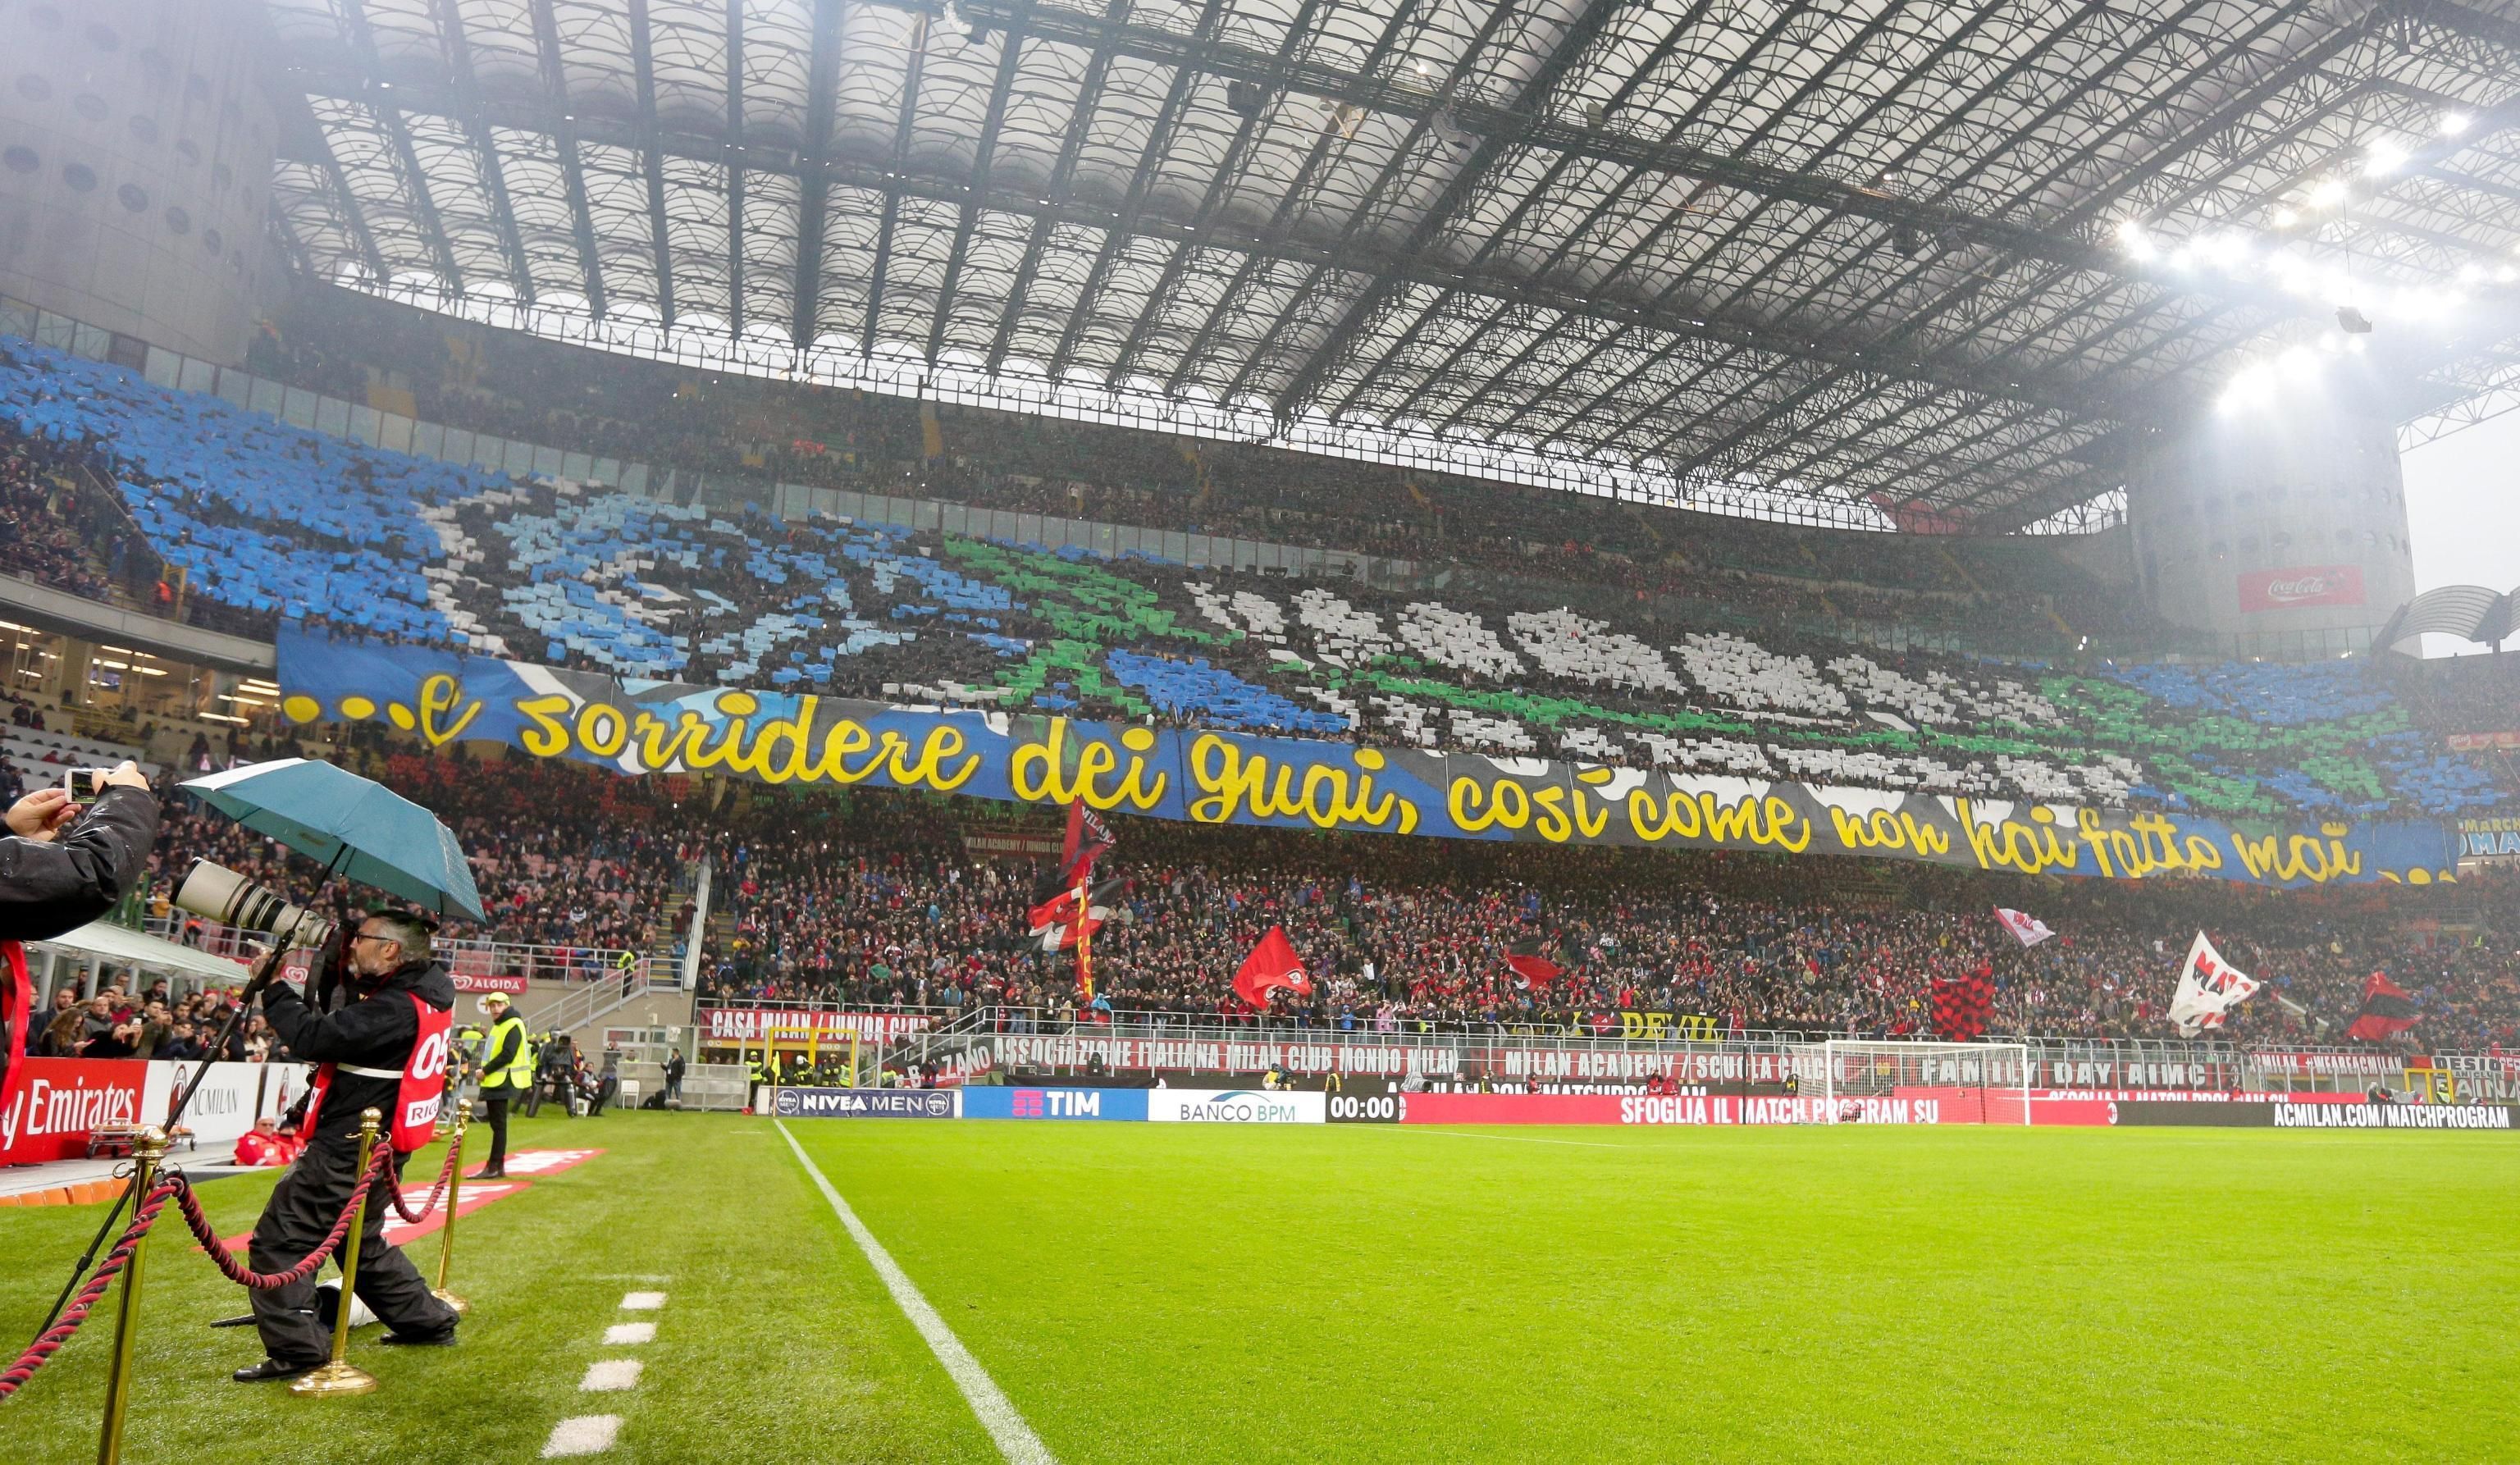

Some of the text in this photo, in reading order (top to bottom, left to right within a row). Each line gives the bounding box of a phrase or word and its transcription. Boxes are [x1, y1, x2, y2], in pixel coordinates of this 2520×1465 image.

[516, 692, 980, 791] sorridere
[1011, 716, 1166, 810] dei
[1189, 734, 1418, 834] guai,
[1628, 788, 1810, 853] come
[1831, 806, 1950, 856] non
[1956, 796, 2078, 874] hai
[2079, 807, 2221, 879] fatto
[987, 837, 1020, 851] ACADEMY
[1025, 840, 1051, 853] JUNIOR
[473, 979, 520, 990] ALGIDA
[712, 1011, 756, 1038] CASA
[760, 1012, 810, 1039] MILAN
[827, 1014, 884, 1042] JUNIOR
[994, 1037, 1459, 1074] ASSOCIAZIONE ITALIANA MILAN CLUB MONDO MILAN
[1505, 1051, 1571, 1076] MILAN
[1577, 1052, 1673, 1077] ACADEMY
[1696, 1055, 1772, 1079] SCUOLA
[2054, 1062, 2111, 1086] DAY
[2128, 1063, 2205, 1086] AIMC
[26, 1075, 135, 1135] Emirates
[802, 1094, 922, 1111] NIVEA MEN
[1046, 1092, 1100, 1116] TIM
[1180, 1104, 1295, 1122] BANCO BPM
[1330, 1096, 1394, 1119] 00:00
[1621, 1097, 1707, 1124] SFOGLIA
[1714, 1098, 1732, 1124] IL
[1738, 1098, 1804, 1124] MATCH
[1914, 1099, 1938, 1124] SU
[2274, 1104, 2509, 1129] ACMILAN.COM/MATCHPROGRAM
